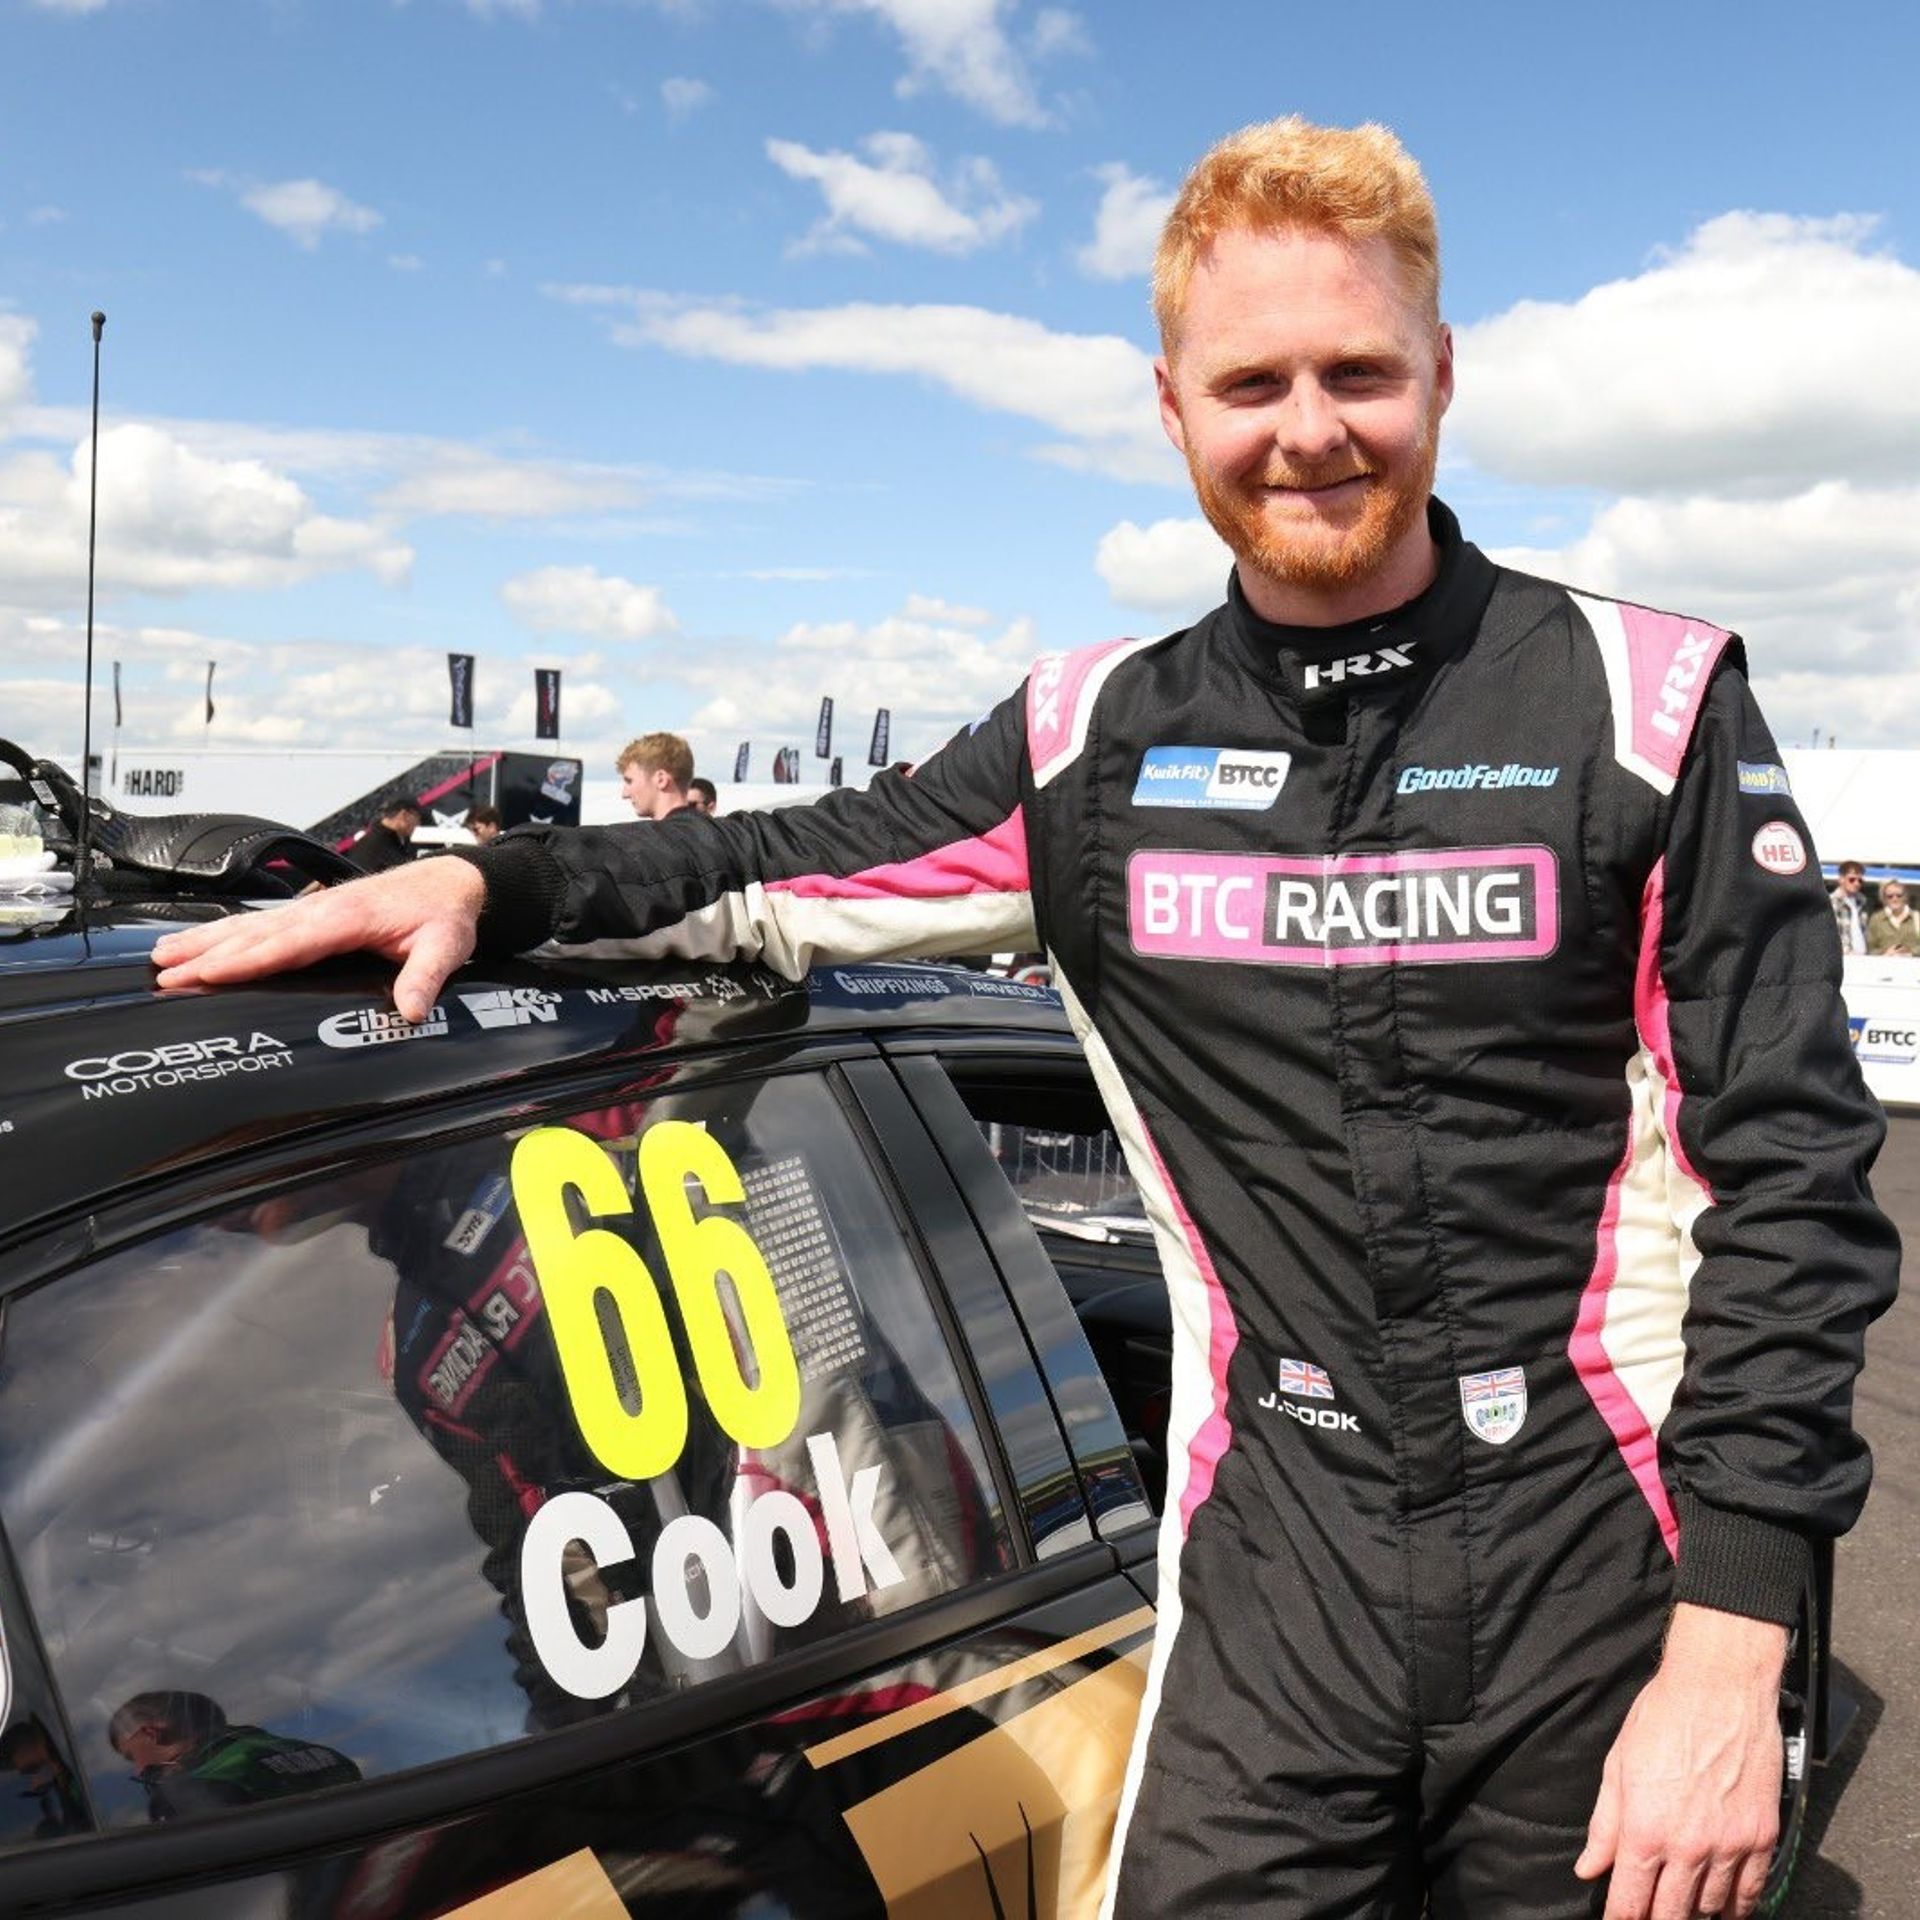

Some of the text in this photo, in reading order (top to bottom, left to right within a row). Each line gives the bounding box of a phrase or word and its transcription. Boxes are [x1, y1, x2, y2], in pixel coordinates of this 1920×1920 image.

[1304, 641, 1418, 689] HRX
[1650, 631, 1713, 737] HRX
[1034, 651, 1071, 734] RX
[1217, 763, 1279, 789] BTCC
[1396, 763, 1560, 794] GoodFellow
[1142, 872, 1521, 942] BTC RACING
[317, 1005, 449, 1049] Eibah
[1867, 1029, 1916, 1046] BTCC
[64, 1032, 288, 1080] COBRA
[81, 1050, 294, 1100] MOTORSPORT
[510, 1120, 801, 1481] 66
[521, 1431, 906, 1699] Cook
